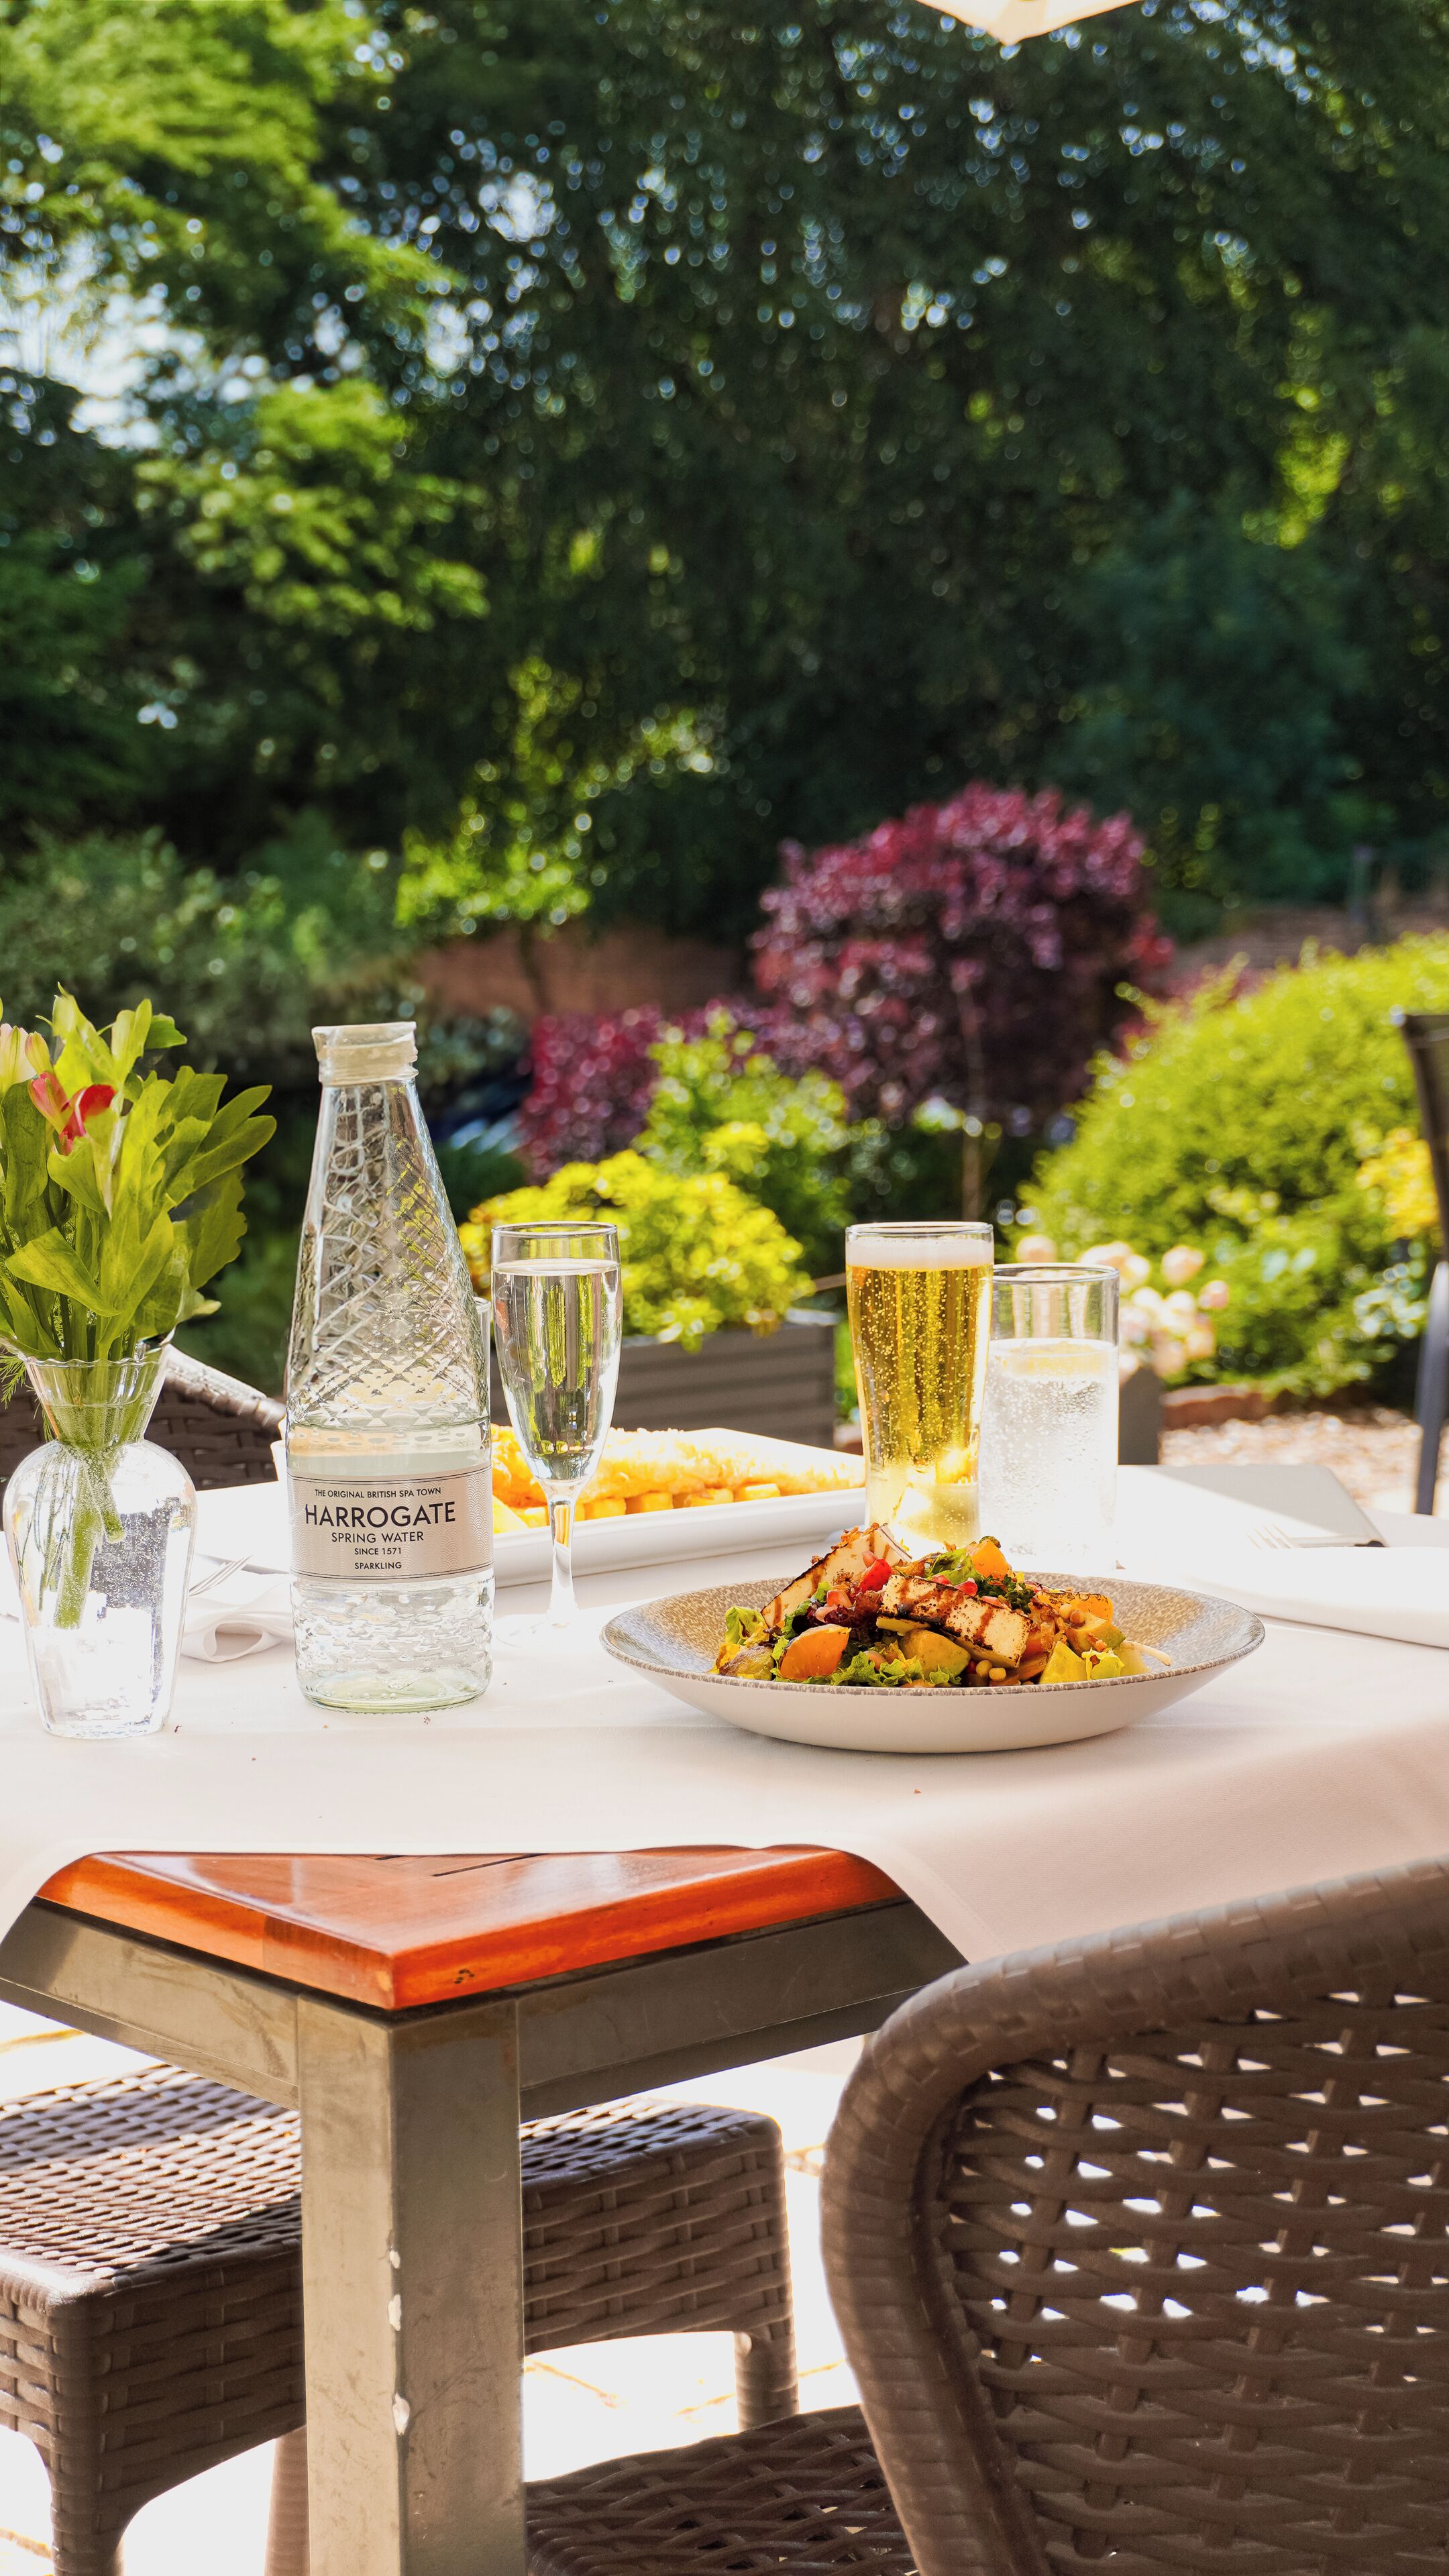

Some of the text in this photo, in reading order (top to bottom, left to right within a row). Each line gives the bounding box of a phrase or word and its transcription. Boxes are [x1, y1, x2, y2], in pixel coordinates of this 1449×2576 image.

[315, 1489, 326, 1497] THE
[327, 1490, 364, 1498] ORIGINAL
[417, 1487, 441, 1496] TOWN
[305, 1501, 455, 1527] HARROGATE
[331, 1532, 424, 1543] SPRING WATER
[354, 1562, 402, 1570] SPARKLING
